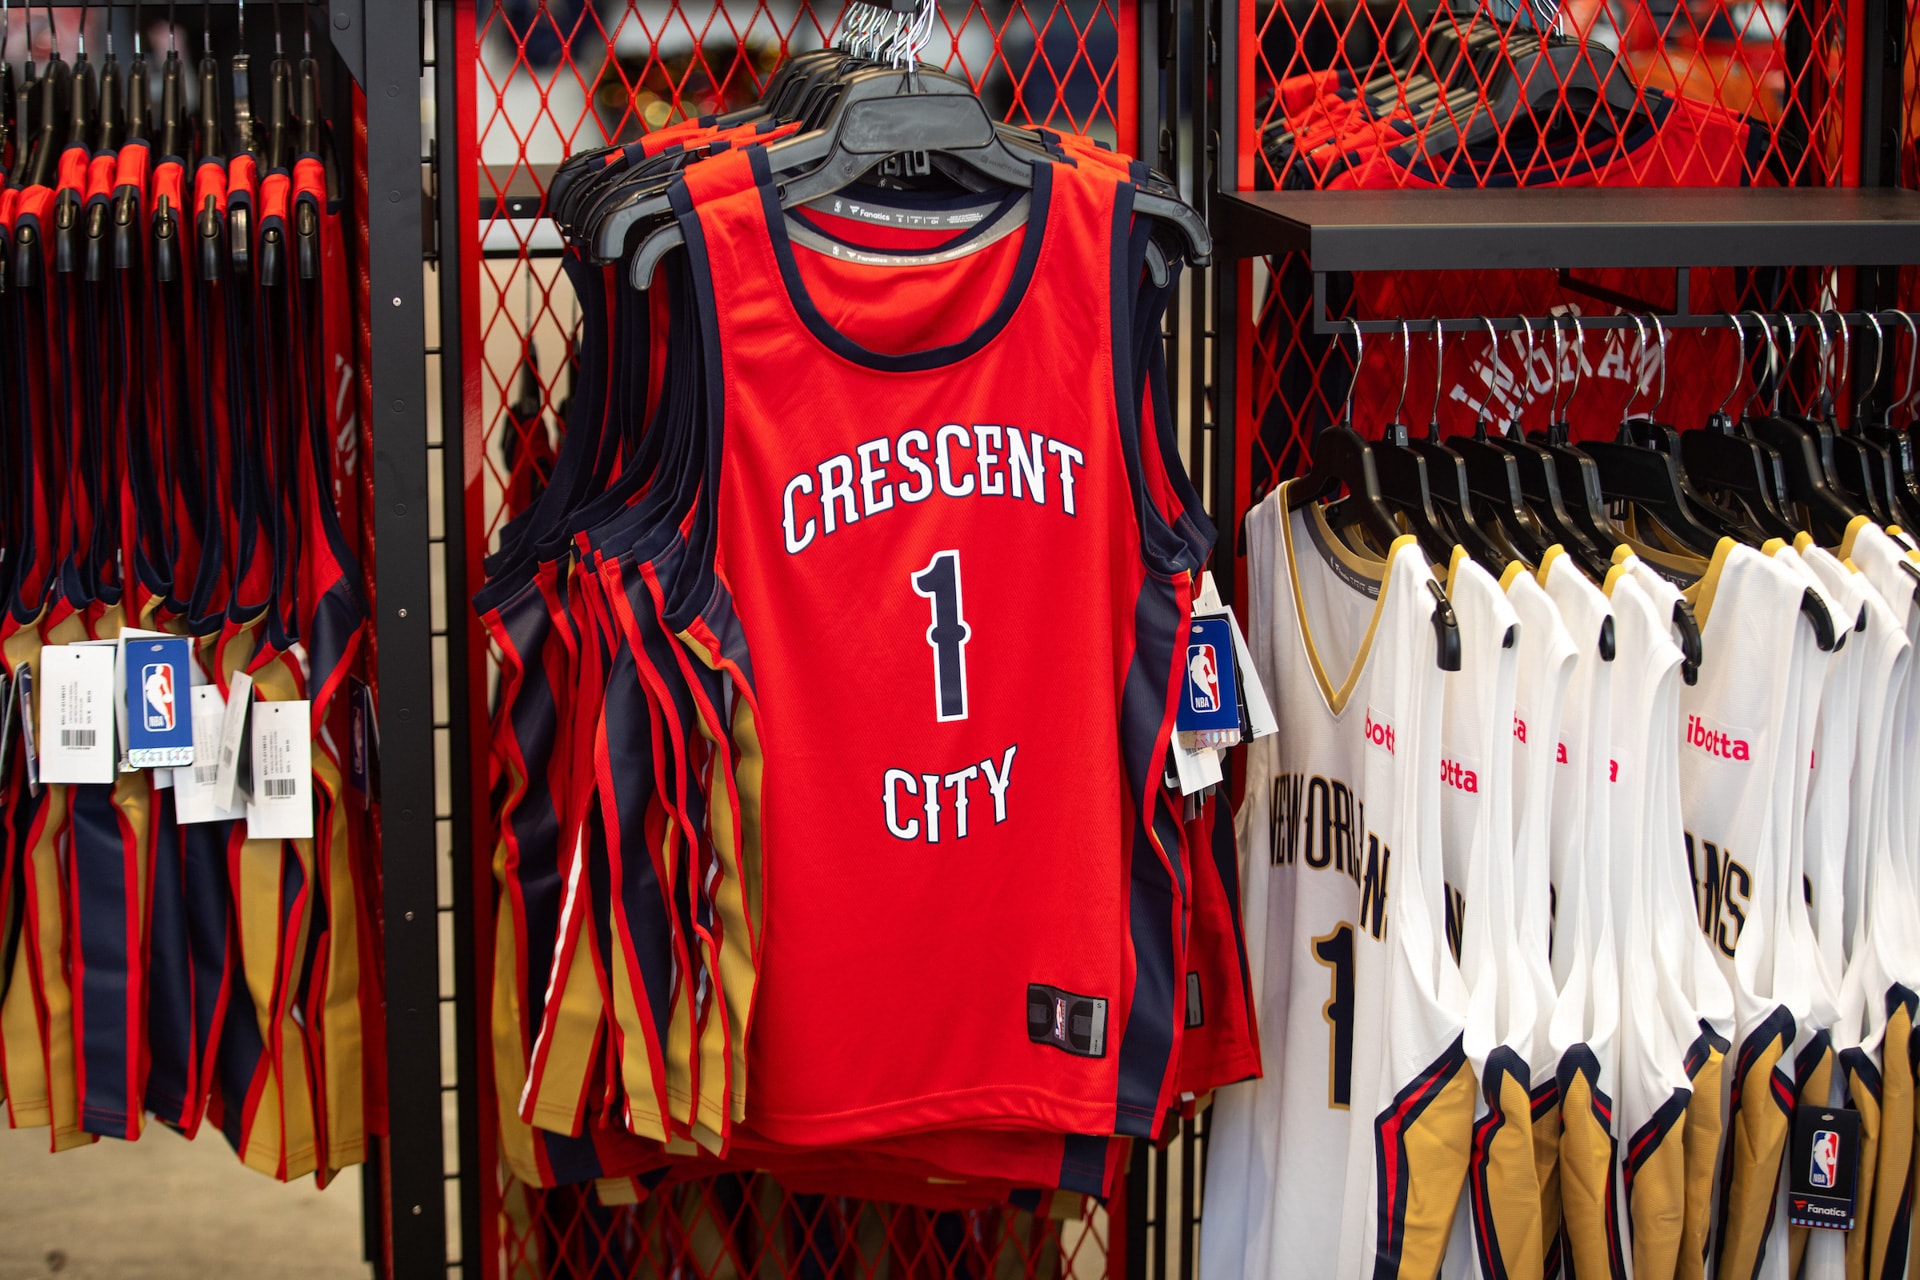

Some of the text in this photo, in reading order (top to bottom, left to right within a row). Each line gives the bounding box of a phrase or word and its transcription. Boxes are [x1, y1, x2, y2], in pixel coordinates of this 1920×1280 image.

[860, 209, 890, 221] Fanatics
[857, 255, 887, 264] Fanatics
[782, 423, 1085, 555] CRESCENT
[911, 549, 972, 723] 1
[1195, 696, 1210, 709] NBA
[148, 715, 165, 728] NBA
[1686, 714, 1751, 762] ibotta
[1440, 759, 1479, 793] otta
[882, 743, 1018, 844] CITY
[1311, 920, 1355, 1111] 1
[1812, 1173, 1826, 1184] NBA
[1807, 1204, 1847, 1218] Fanatics
